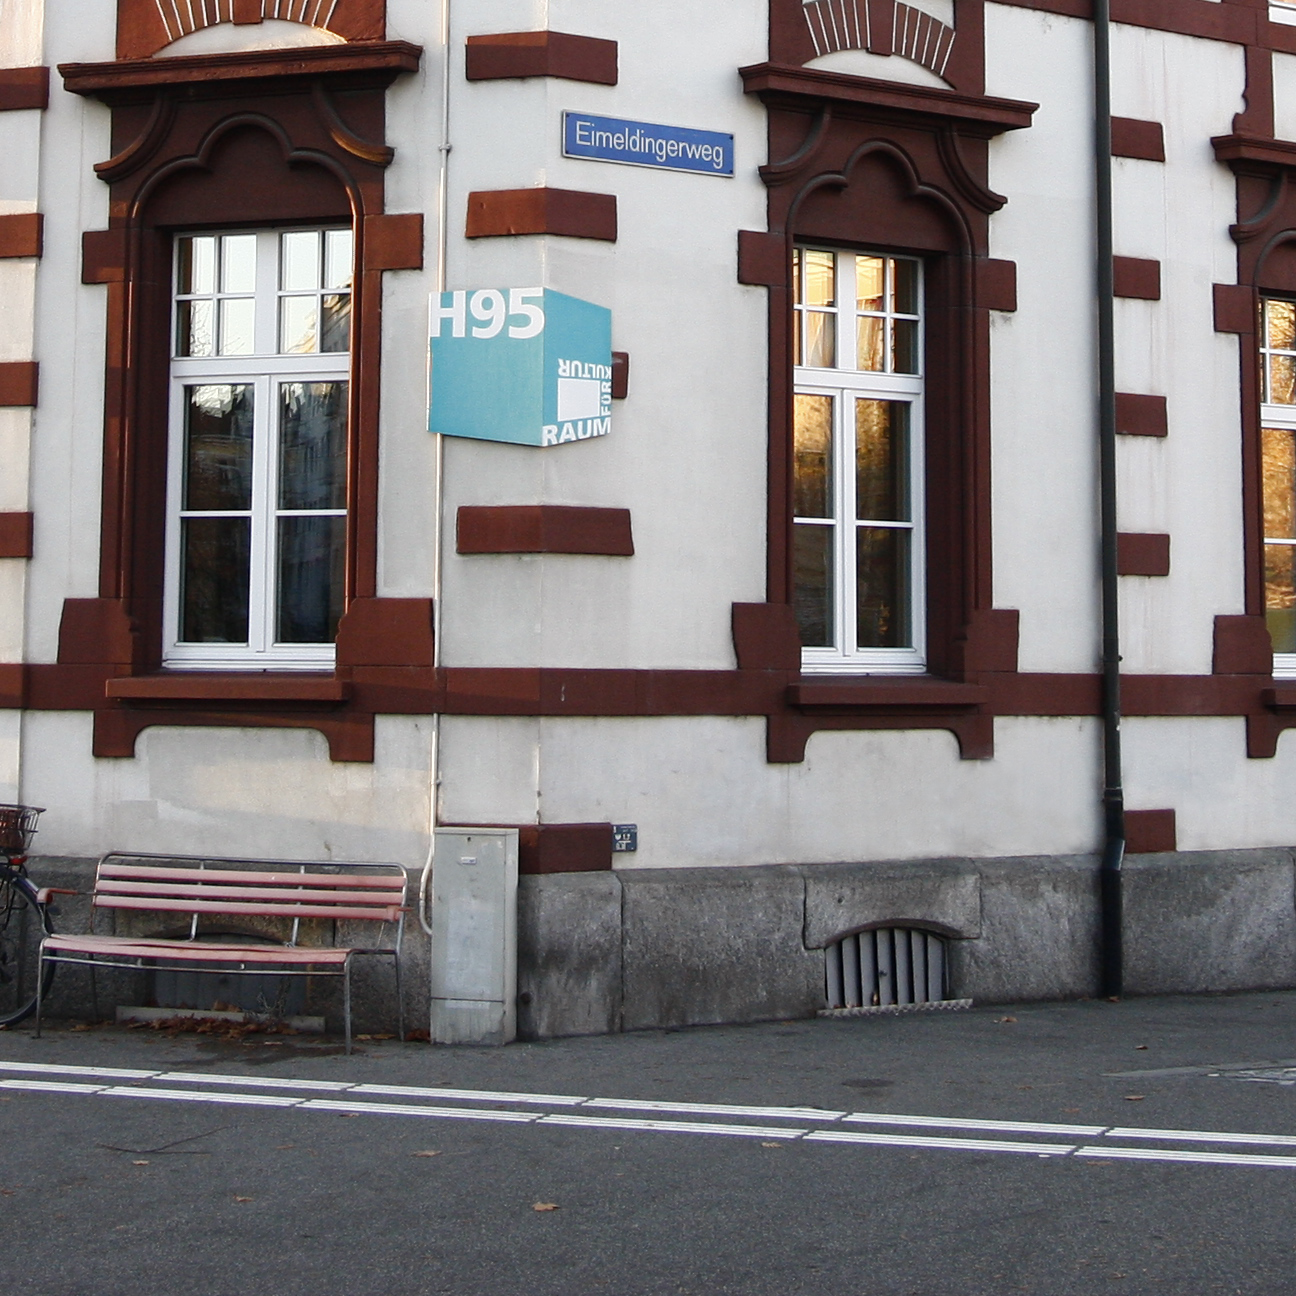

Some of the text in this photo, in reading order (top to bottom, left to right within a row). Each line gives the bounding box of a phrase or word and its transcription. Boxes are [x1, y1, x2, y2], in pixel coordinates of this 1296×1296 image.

[576, 120, 724, 169] Eimeldingerweg
[429, 287, 545, 339] H95
[557, 358, 612, 380] KULTUR
[542, 417, 611, 447] RAUM
